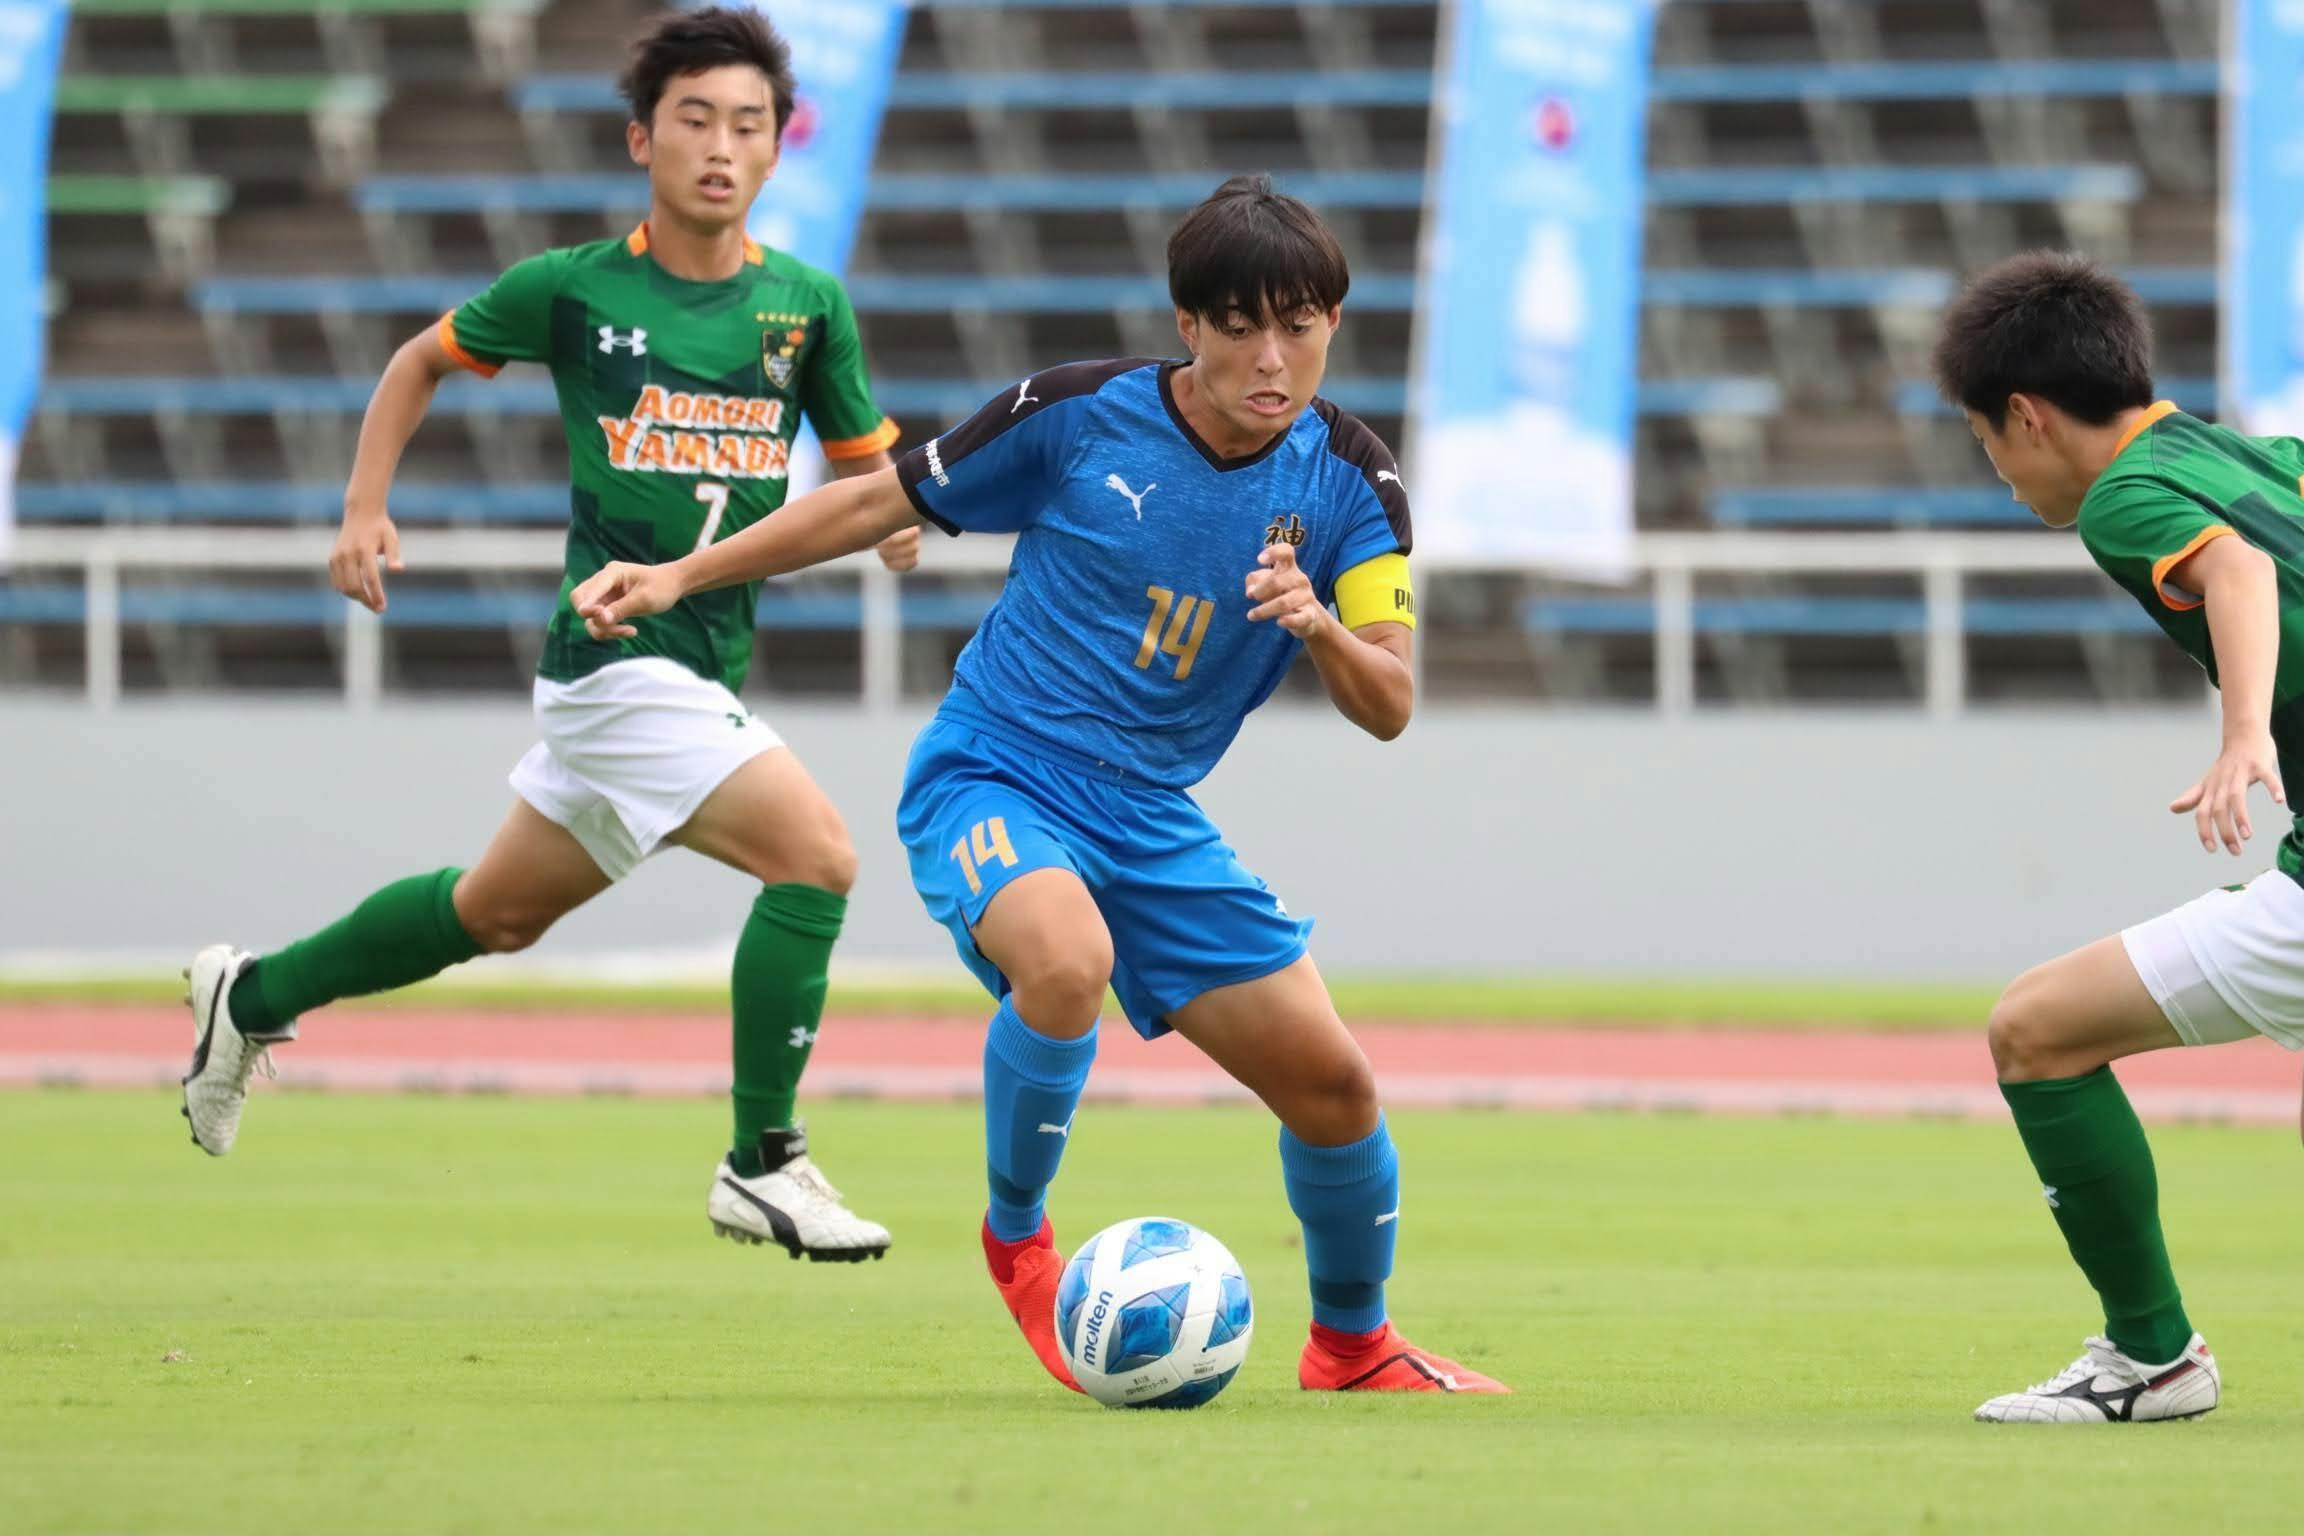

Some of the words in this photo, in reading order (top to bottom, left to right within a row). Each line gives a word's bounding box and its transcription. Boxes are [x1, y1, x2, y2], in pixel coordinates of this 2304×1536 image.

[631, 385, 783, 433] AOMORI
[598, 415, 788, 479] YAMADA
[695, 482, 730, 552] 7
[1134, 585, 1215, 680] 14
[951, 816, 1019, 896] 14
[1084, 1290, 1114, 1366] molten
